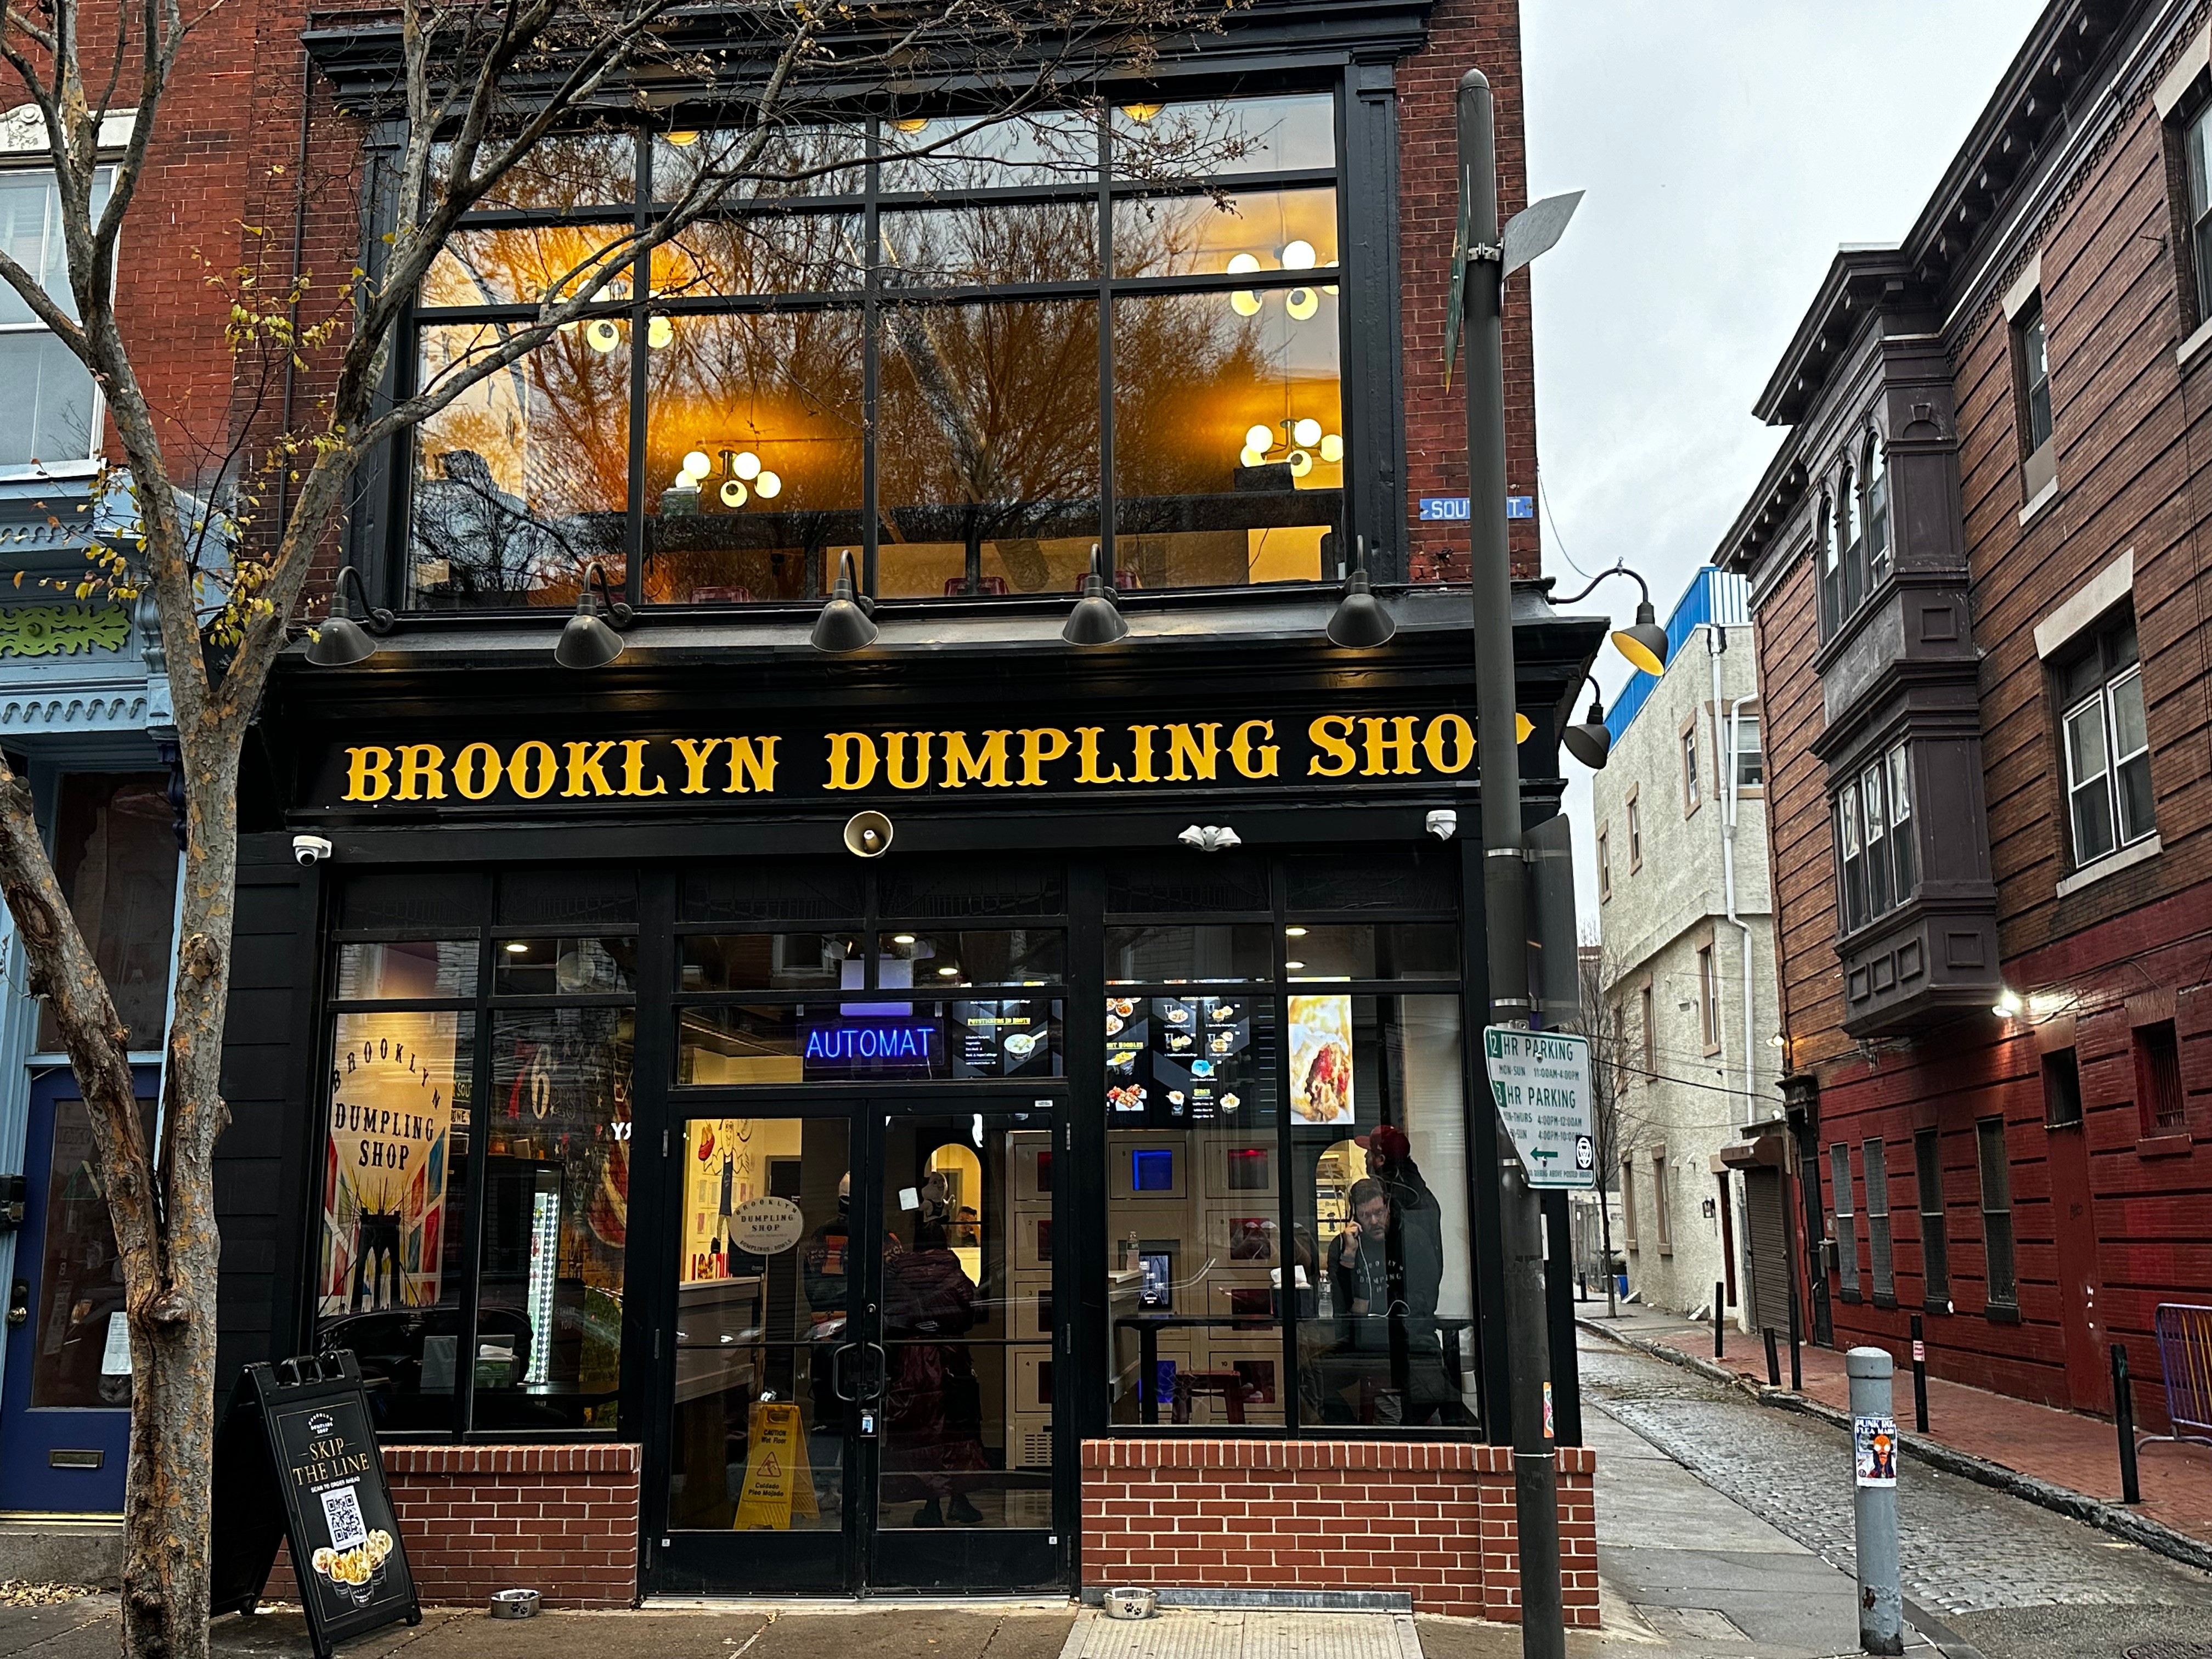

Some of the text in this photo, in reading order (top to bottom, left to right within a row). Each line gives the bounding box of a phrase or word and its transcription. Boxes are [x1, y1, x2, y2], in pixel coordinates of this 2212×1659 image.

[1431, 499, 1528, 518] SOU T.
[341, 736, 782, 802] BROOKLYN
[822, 719, 1280, 790] DUMPLING
[806, 1028, 935, 1059] AUTOMAT
[1492, 1035, 1573, 1062] 2 HR PARKING
[332, 1038, 441, 1110] BROOKLYN
[1495, 1082, 1576, 1109] 3 HR PARKING
[334, 1103, 434, 1142] DUMPLING
[358, 1139, 410, 1171] SHOP
[736, 1199, 797, 1215] BROOKLYN
[741, 1214, 793, 1223] DUMPLING
[309, 1437, 344, 1462] SKIP
[773, 1436, 786, 1444] Floor
[292, 1453, 370, 1486] THE LINE
[311, 1485, 323, 1493] SCAN
